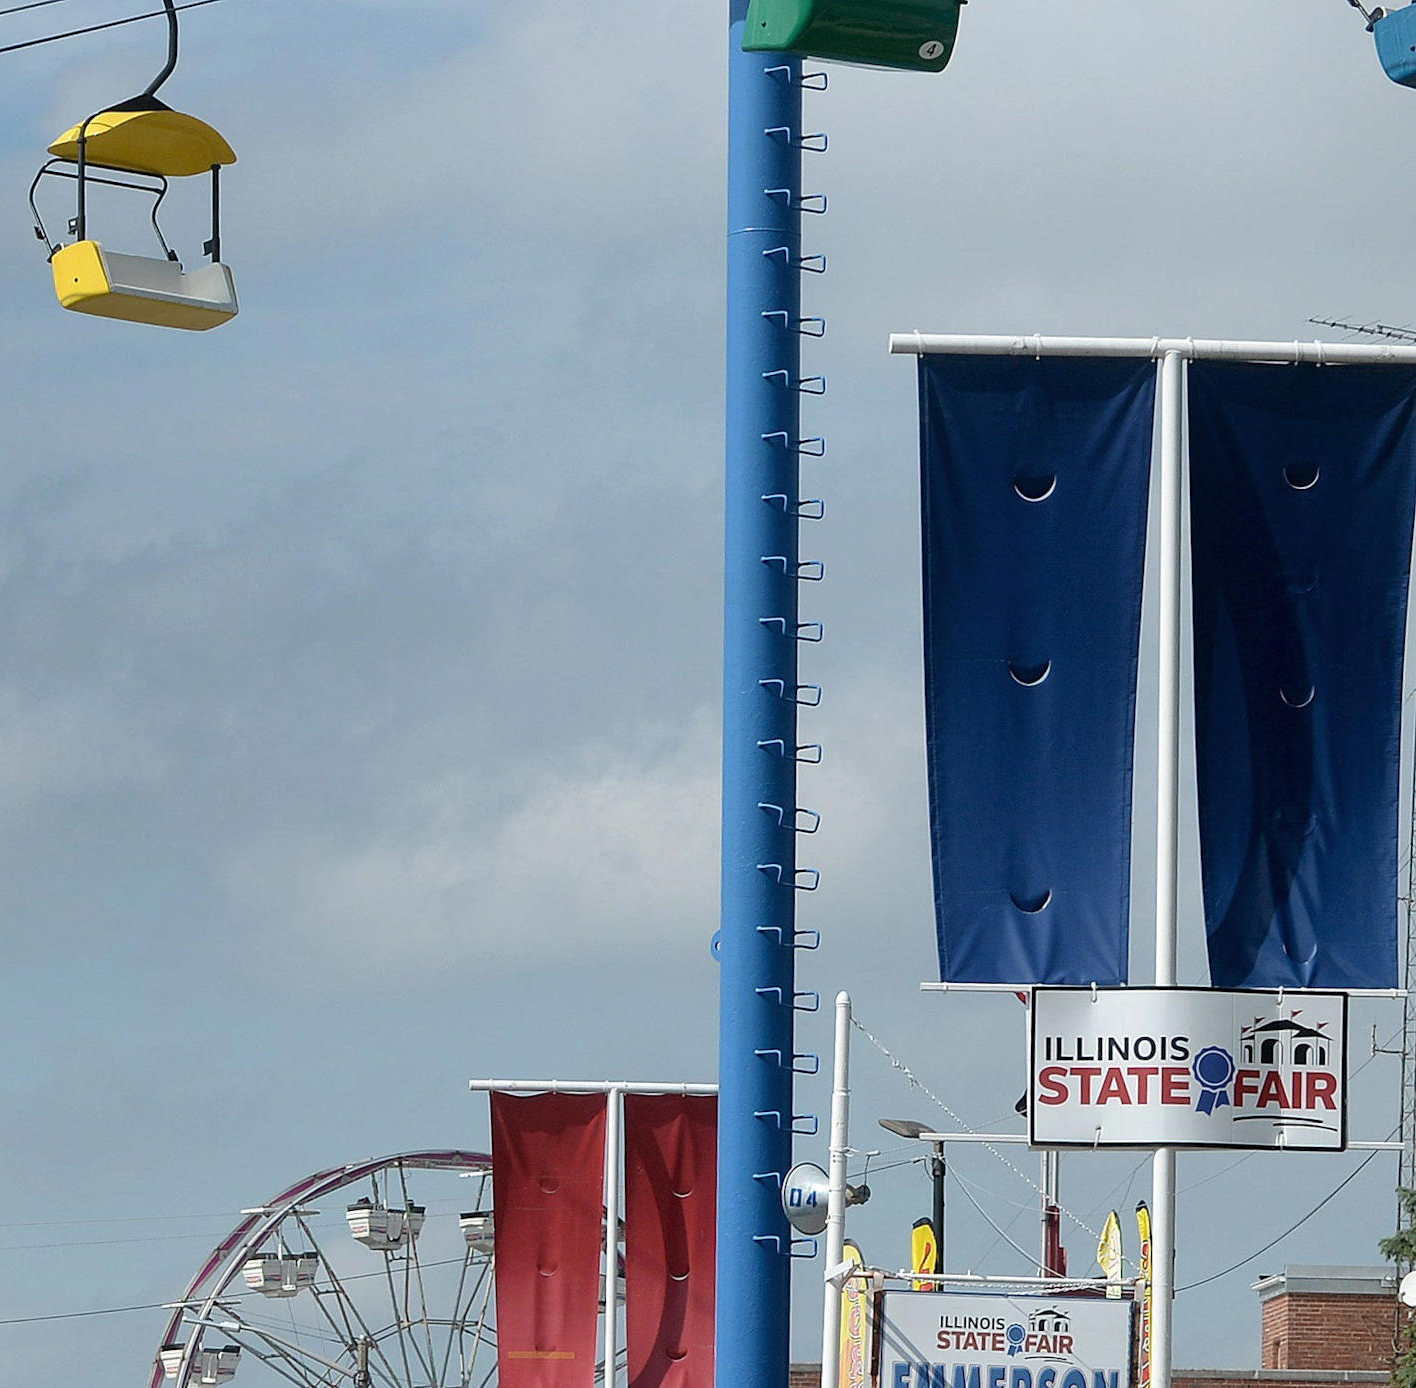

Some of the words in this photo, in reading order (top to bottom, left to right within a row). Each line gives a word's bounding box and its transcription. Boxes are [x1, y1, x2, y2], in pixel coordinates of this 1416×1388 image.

[1044, 1036, 1190, 1062] ILLINOIS
[1037, 1065, 1192, 1107] STATE
[1233, 1069, 1338, 1110] FAIR
[939, 1315, 1005, 1330] ILLINOIS
[937, 1330, 1006, 1352] STATE
[1024, 1332, 1074, 1355] FAIR
